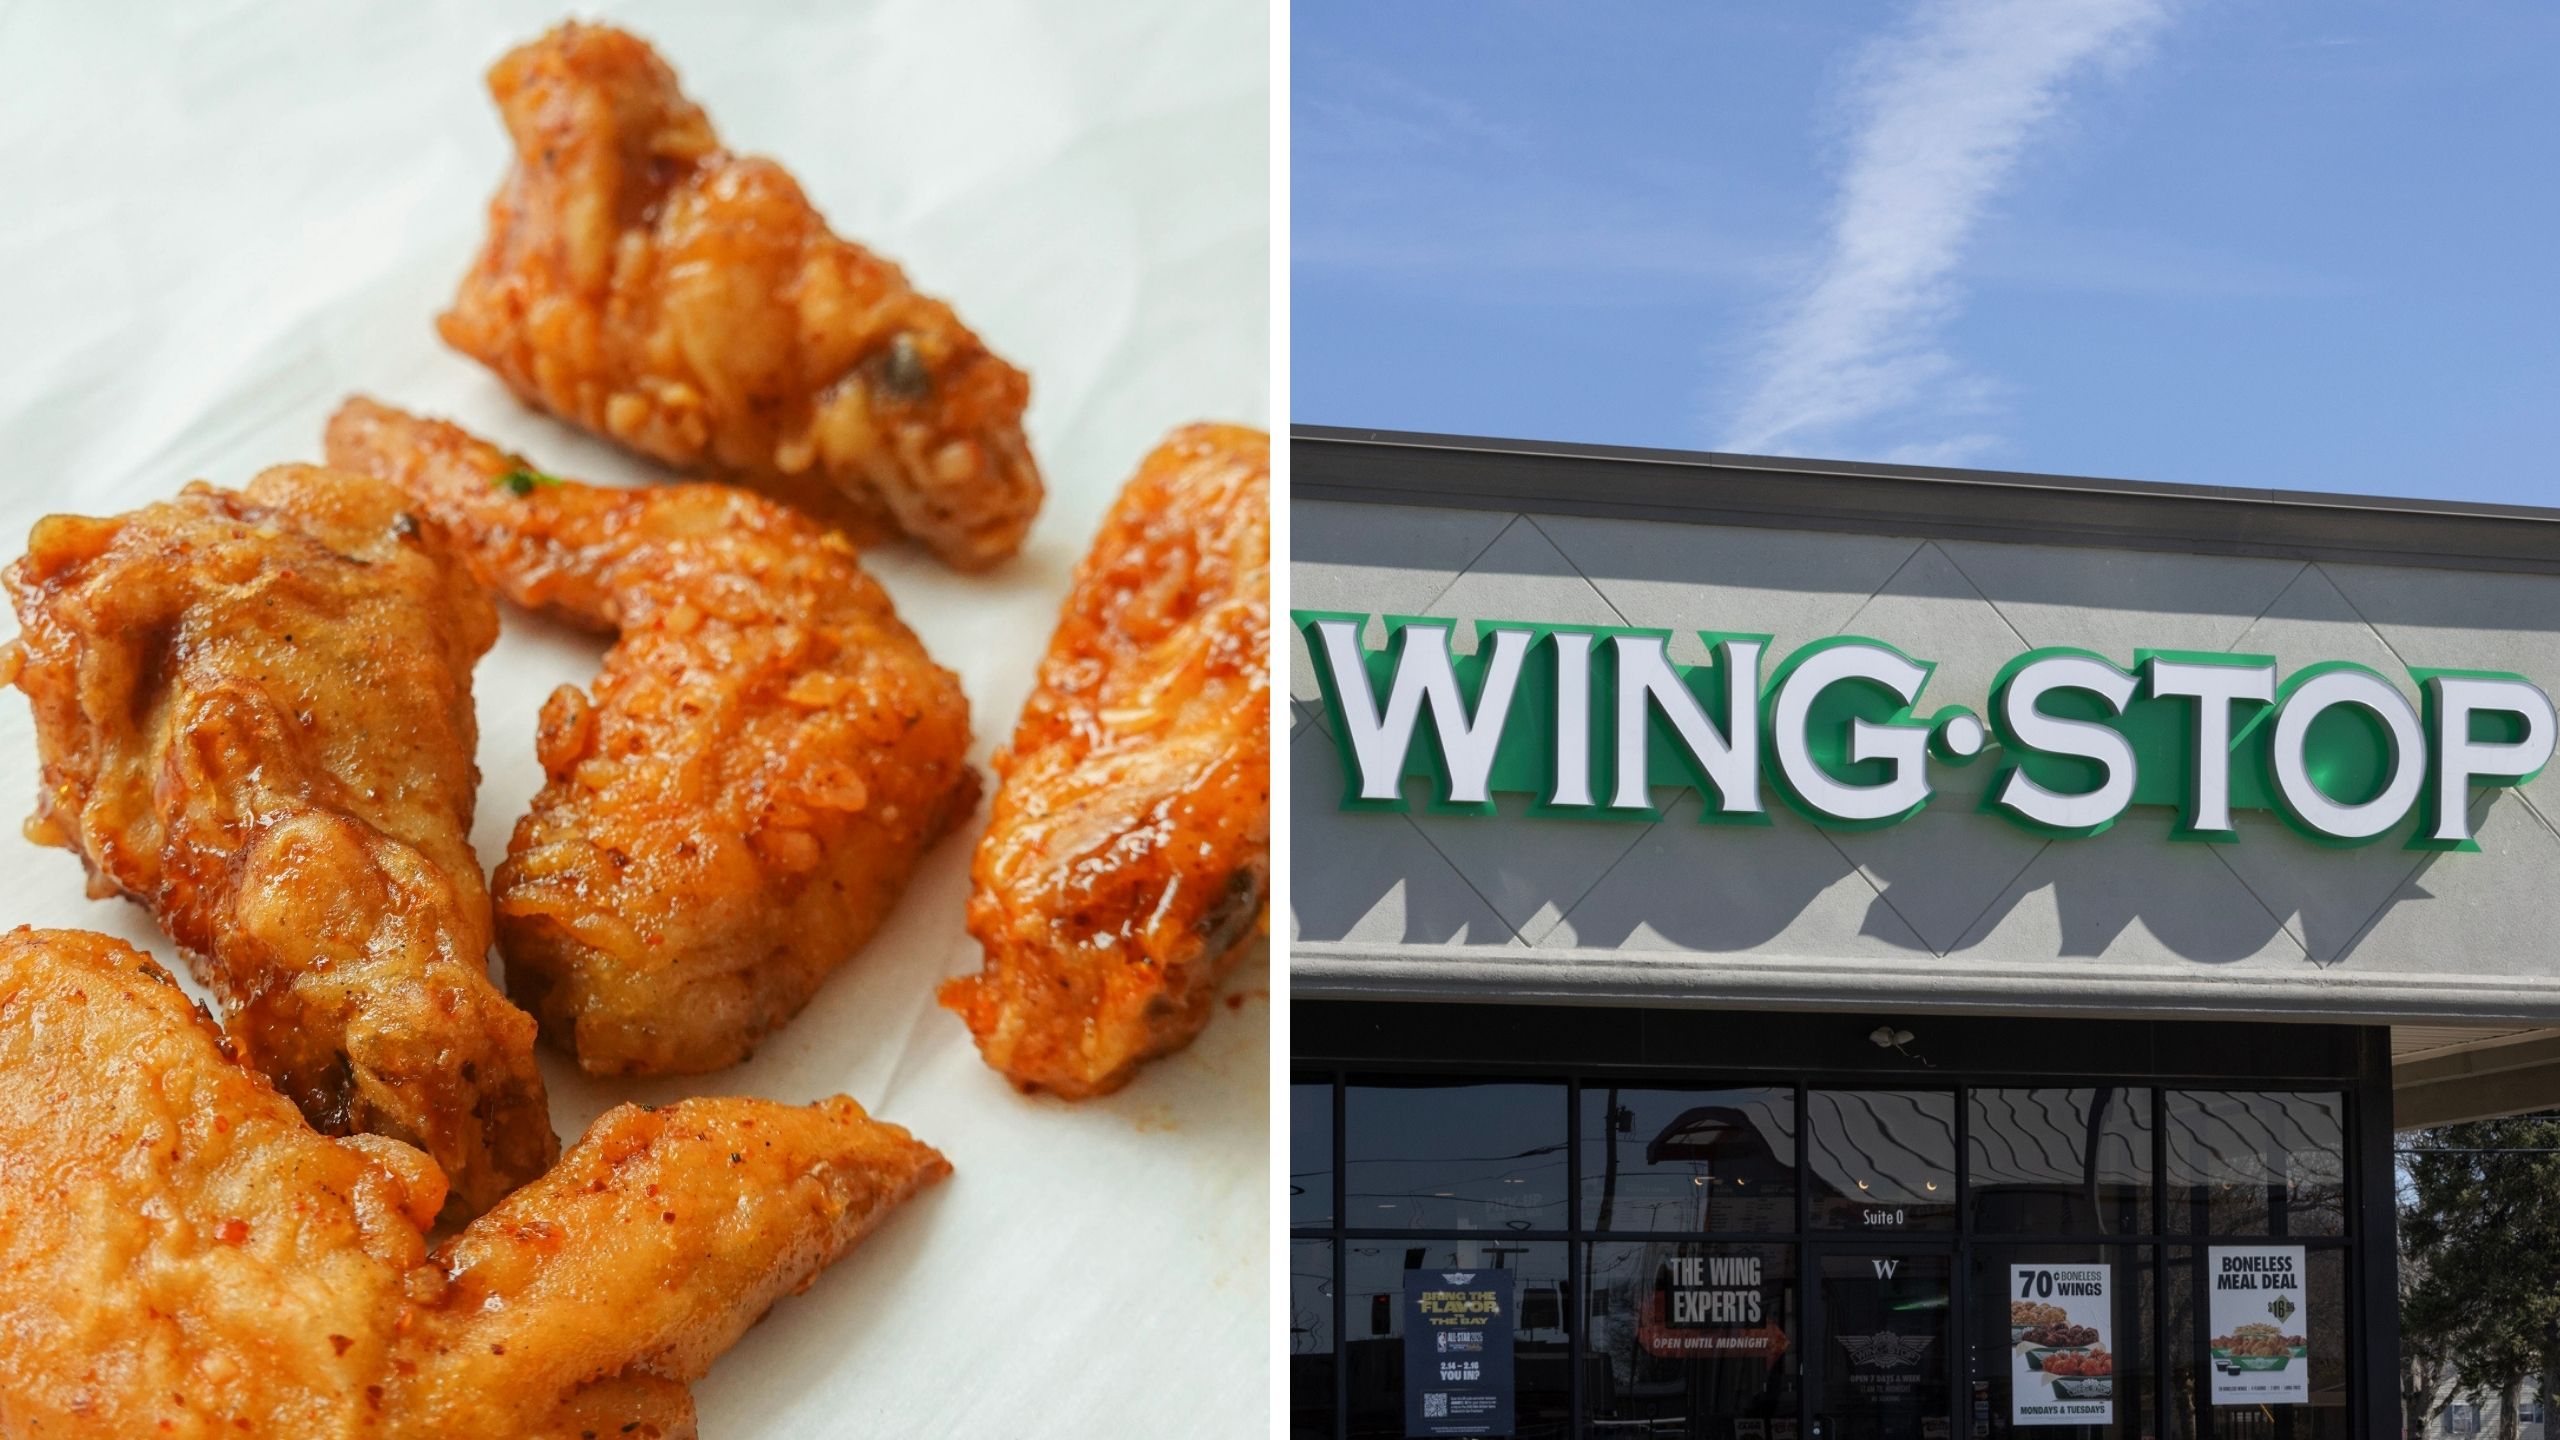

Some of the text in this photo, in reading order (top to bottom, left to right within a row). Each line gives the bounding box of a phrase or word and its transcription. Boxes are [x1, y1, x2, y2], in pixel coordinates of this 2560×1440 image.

[1863, 1208, 1894, 1225] Suite
[1872, 1259, 1899, 1280] W
[2222, 1256, 2292, 1272] BONELESS
[1670, 1257, 1761, 1286] THE WING
[2061, 1271, 2102, 1281] BONELESS
[2217, 1273, 2298, 1290] MEAL DEAL
[1422, 1291, 1496, 1300] BRING THE
[2057, 1283, 2102, 1296] WINGS
[1420, 1301, 1498, 1313] FLAVOR
[1673, 1290, 1761, 1323] EXPERTS
[1460, 1317, 1488, 1325] BAY
[1653, 1338, 1769, 1349] OPEN UNTIL MIDNIGHT
[1440, 1370, 1480, 1381] YOU IN?
[1850, 1374, 1868, 1383] OPEN
[1876, 1374, 1894, 1384] DAYS
[1895, 1374, 1901, 1382] A
[1902, 1374, 1921, 1383] WEEK
[2020, 1405, 2105, 1415] MONDAYS & TUESDAYS
